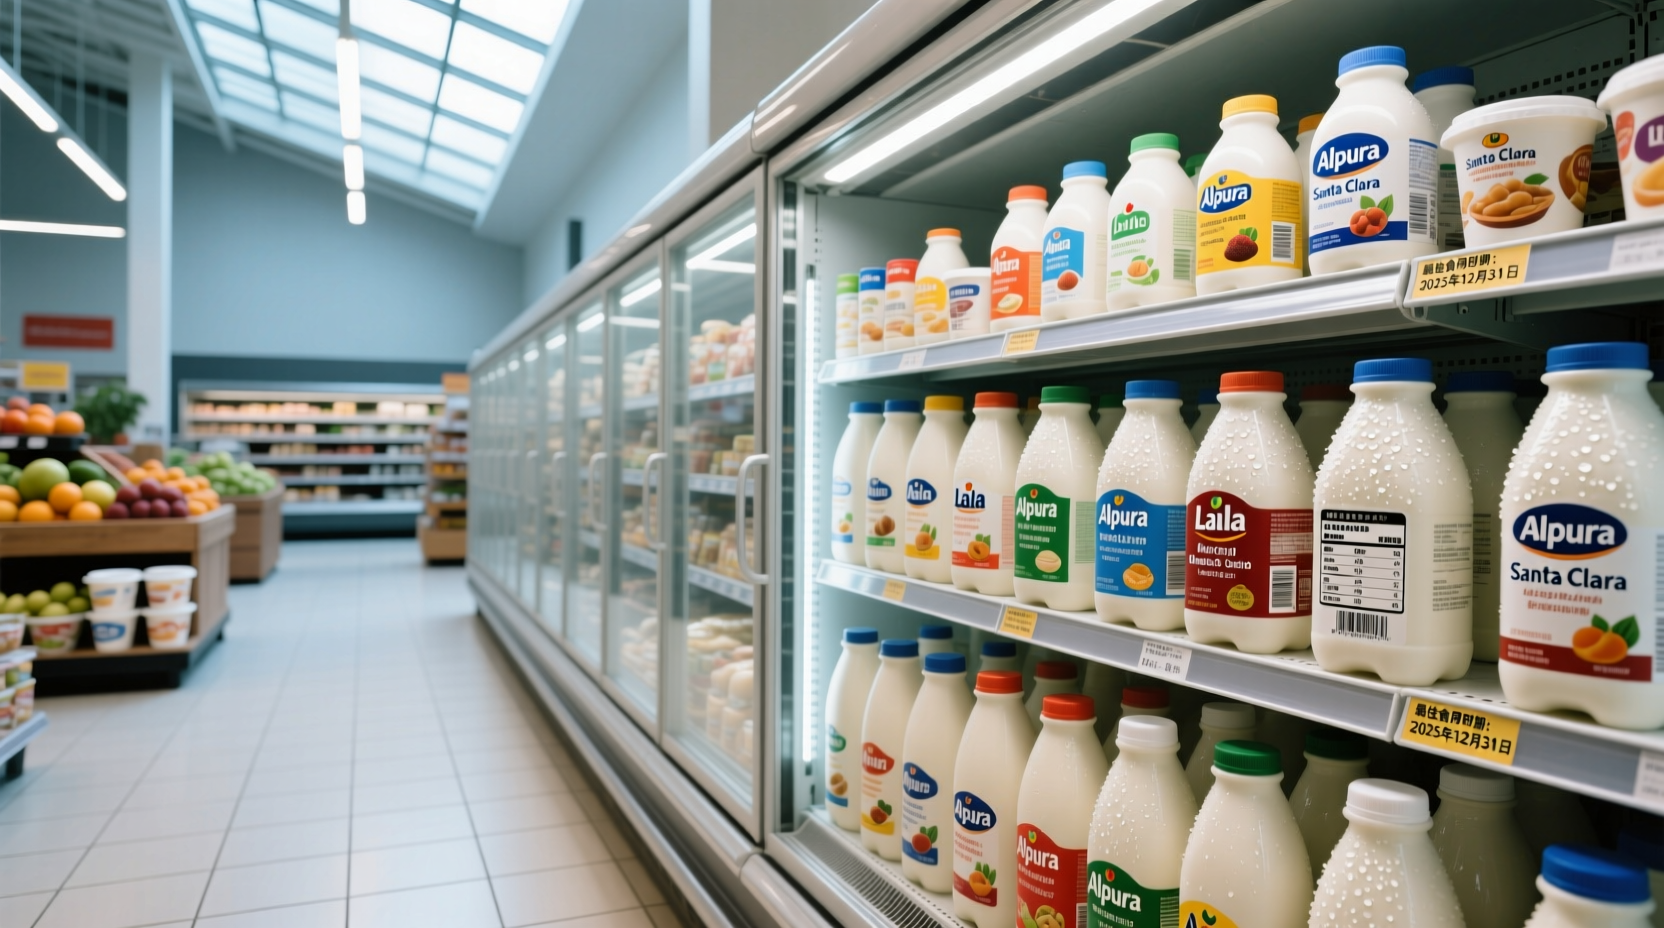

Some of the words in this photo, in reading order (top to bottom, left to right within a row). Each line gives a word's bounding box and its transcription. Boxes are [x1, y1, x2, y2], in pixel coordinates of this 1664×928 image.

[1317, 143, 1380, 173] Alpura
[1201, 185, 1248, 209] Alpura
[1419, 264, 1519, 291] 2025年12月31日
[955, 488, 985, 509] Lala
[1016, 497, 1058, 521] Alpura
[1098, 503, 1148, 530] Alpura
[1519, 515, 1616, 550] Alpura
[1510, 562, 1562, 585] Santa
[1567, 567, 1627, 591] Clara
[1409, 720, 1512, 755] 2025年12月31日
[1017, 835, 1060, 871] Alpura
[1087, 870, 1142, 912] Alpura
